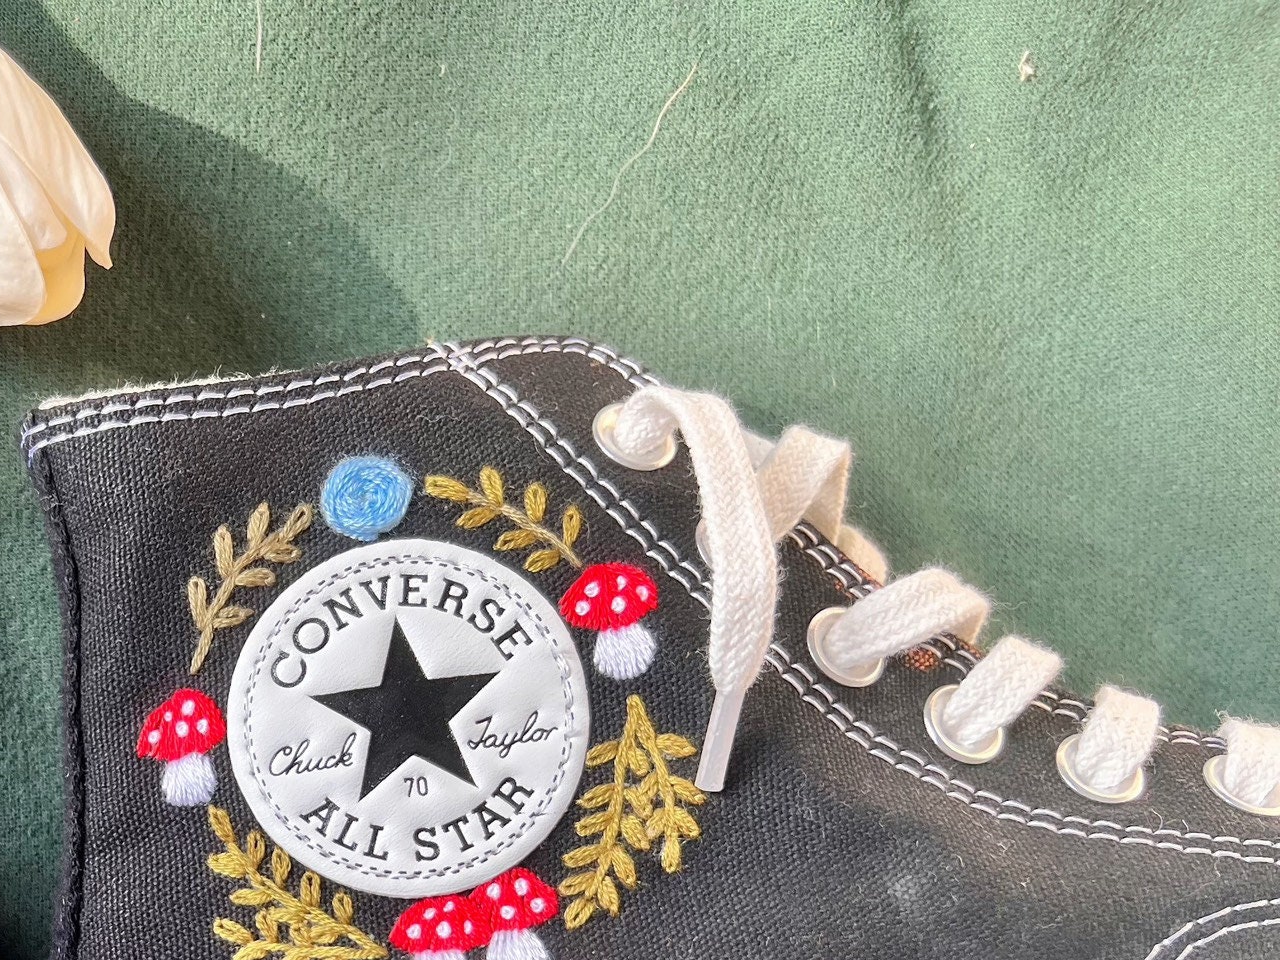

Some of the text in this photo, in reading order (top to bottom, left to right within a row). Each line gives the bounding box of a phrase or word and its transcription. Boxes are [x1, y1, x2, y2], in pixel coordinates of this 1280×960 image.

[272, 574, 533, 688] CONVERSE
[269, 711, 558, 777] Chuck Taylor
[300, 776, 534, 861] ALL STAR
[404, 777, 428, 797] 70
